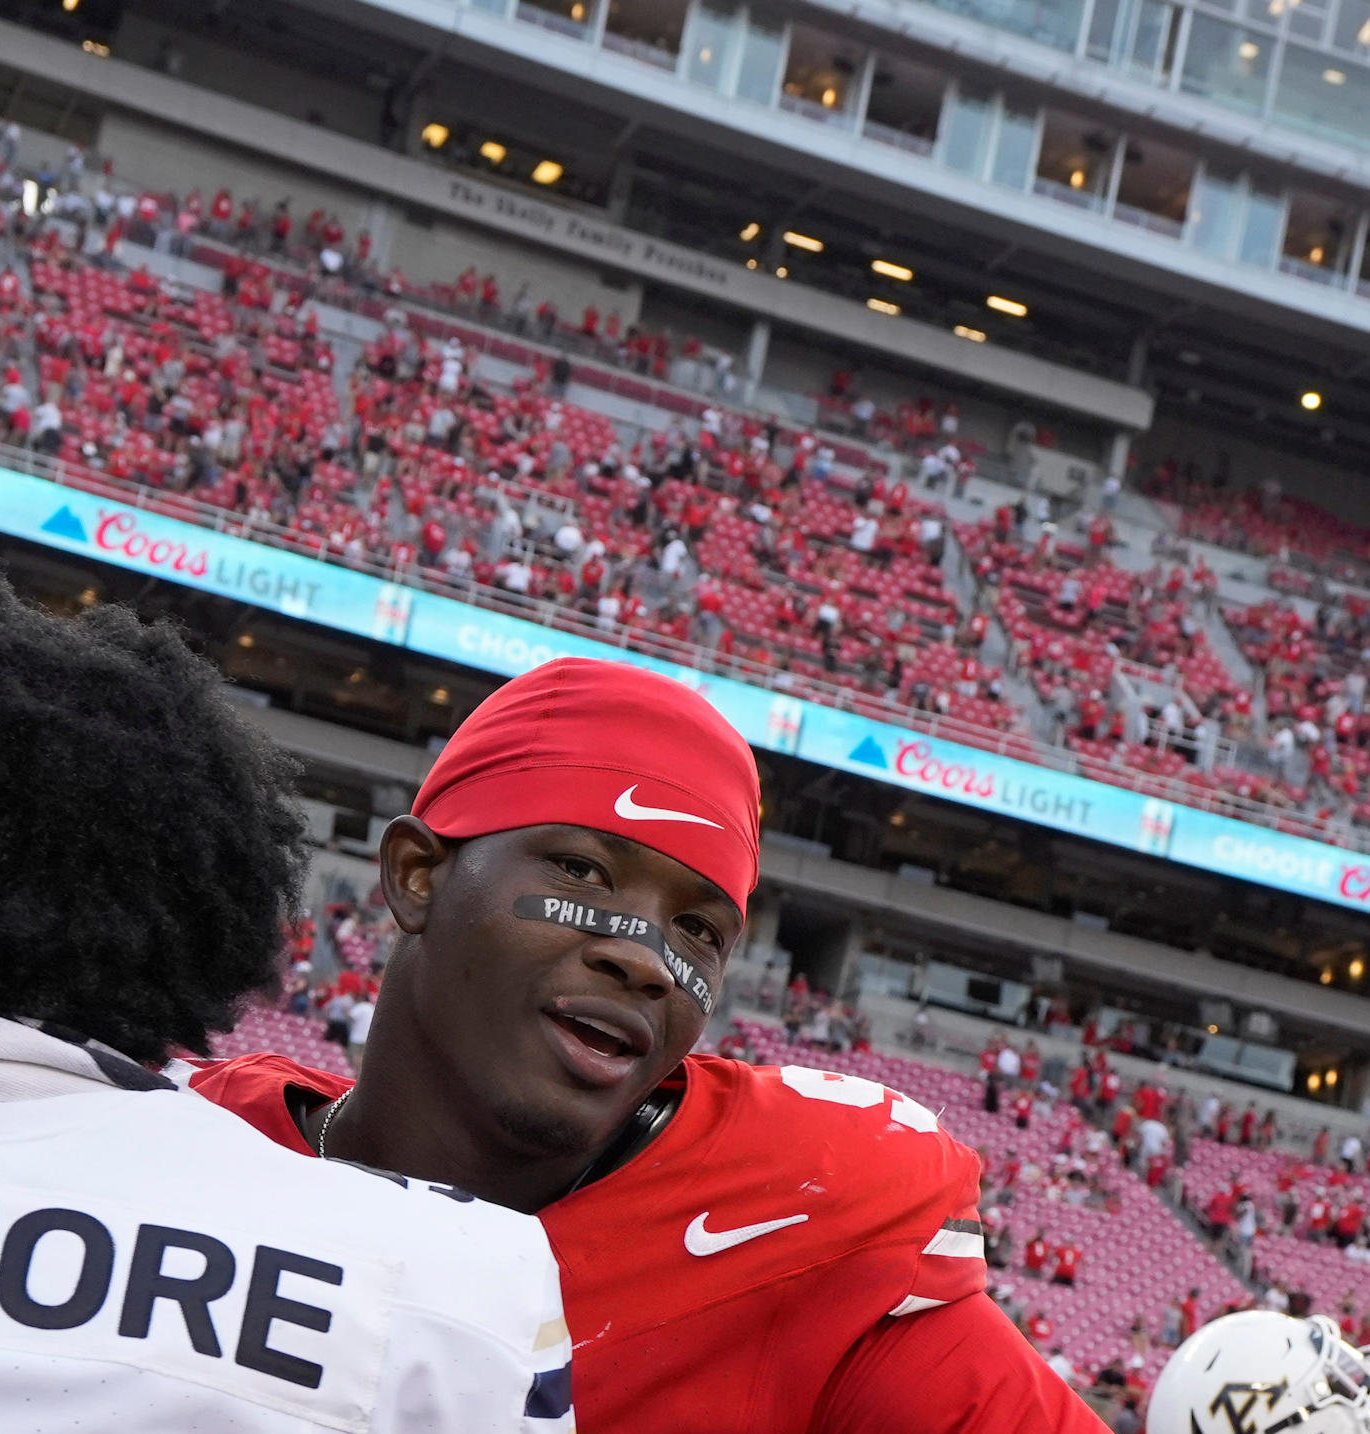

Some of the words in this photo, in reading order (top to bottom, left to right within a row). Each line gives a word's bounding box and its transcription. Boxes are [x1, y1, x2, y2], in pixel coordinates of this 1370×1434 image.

[95, 508, 208, 577] Coors
[215, 556, 323, 607] LIGHT
[895, 737, 994, 798] Coors
[1000, 779, 1094, 825] LIGHT
[1212, 834, 1334, 887] CHOOSE
[543, 897, 597, 927] PHIL
